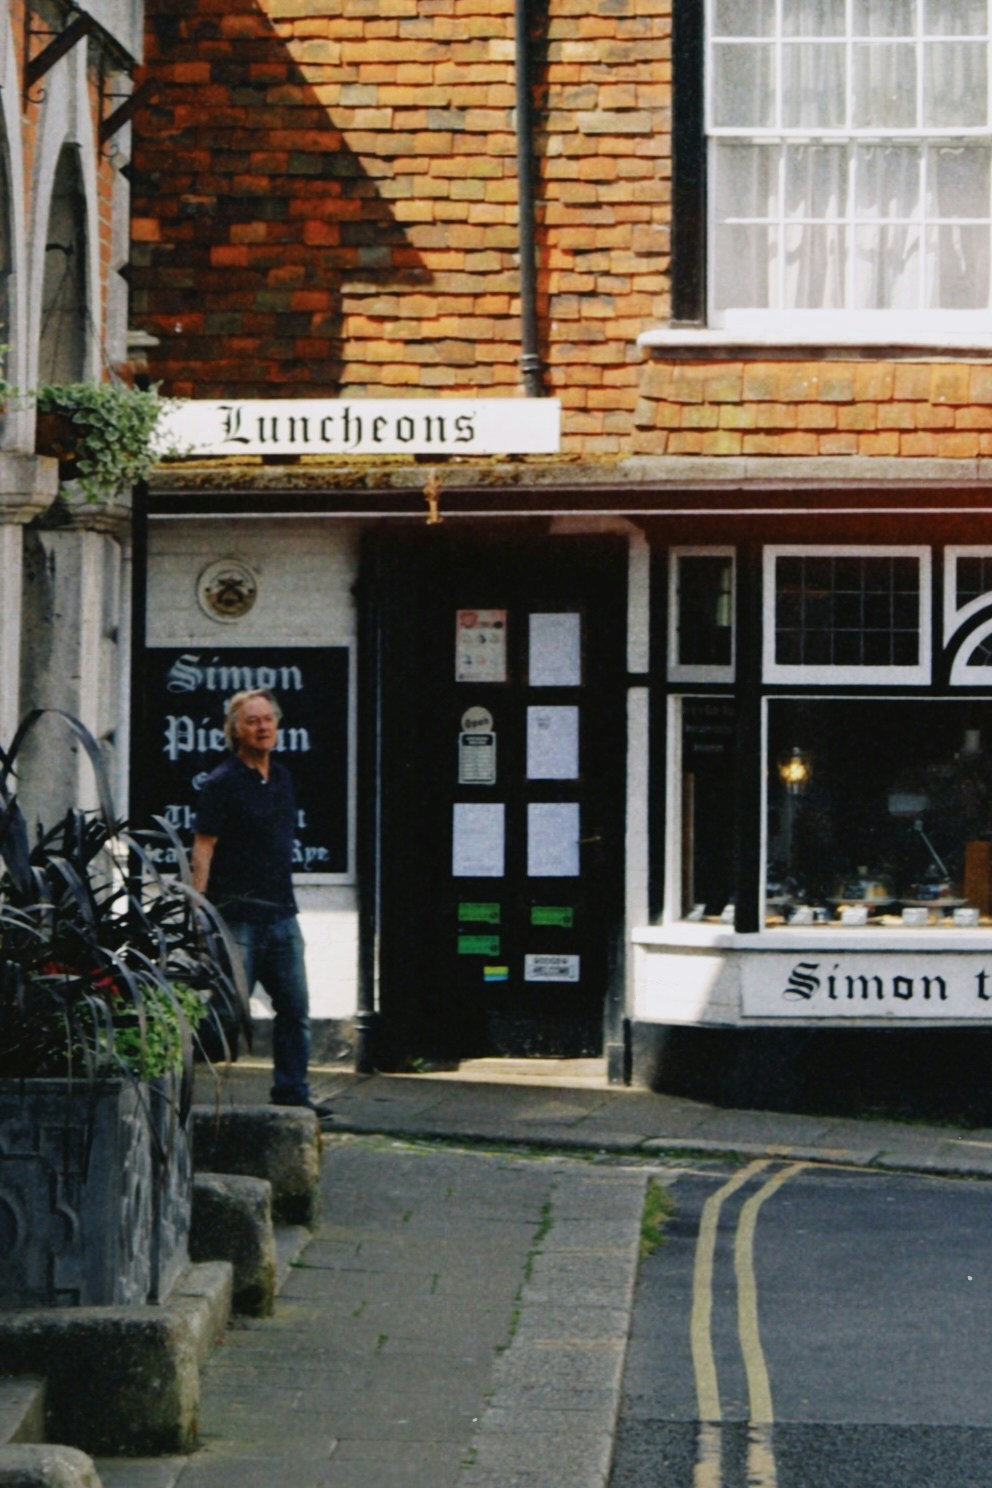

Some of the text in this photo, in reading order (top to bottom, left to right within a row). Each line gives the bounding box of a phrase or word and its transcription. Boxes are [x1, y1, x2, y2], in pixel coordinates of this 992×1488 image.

[217, 405, 477, 449] Luncheons
[167, 654, 304, 693] Simon
[464, 717, 490, 729] Open
[782, 962, 949, 1001] Simon
